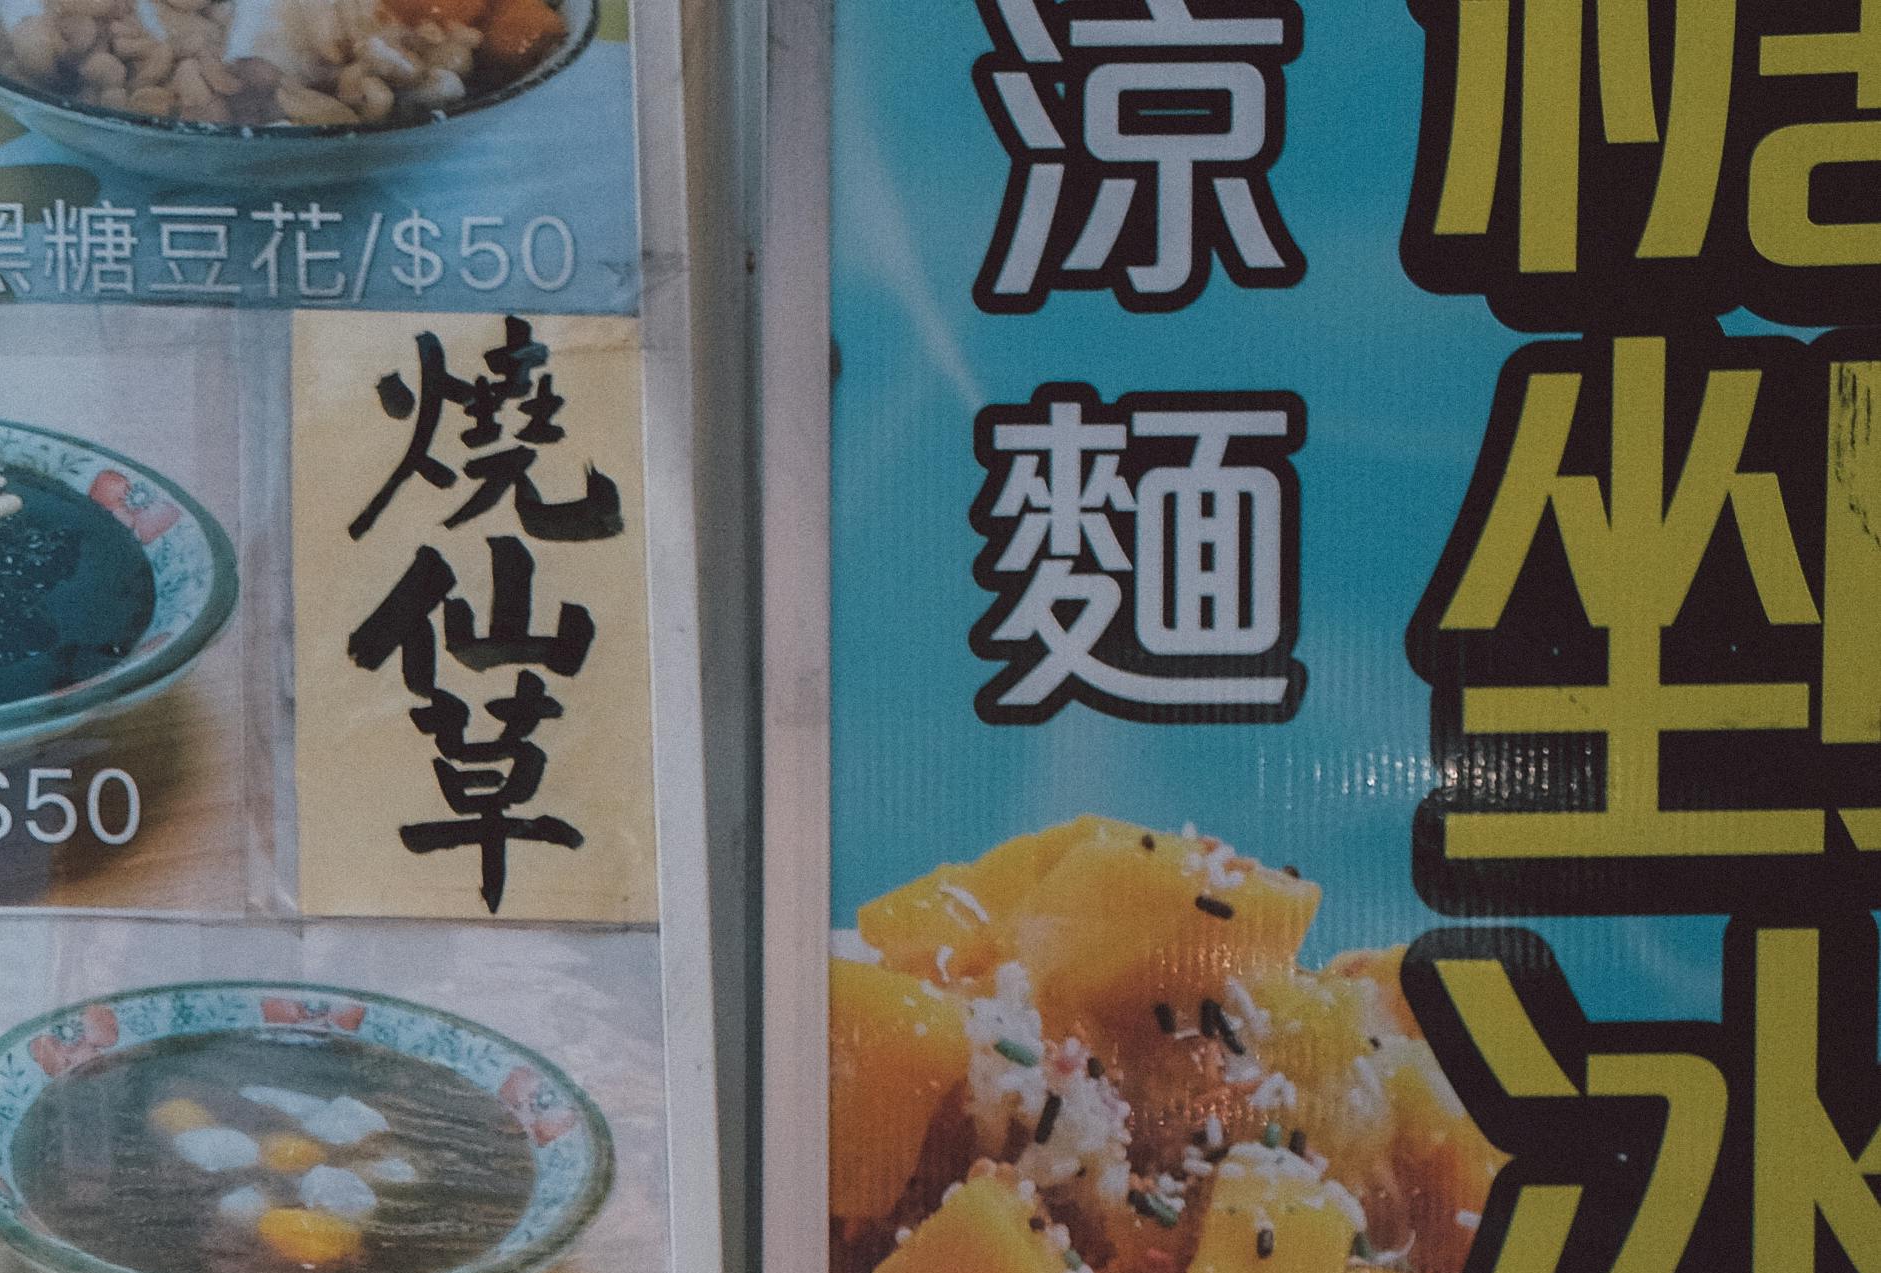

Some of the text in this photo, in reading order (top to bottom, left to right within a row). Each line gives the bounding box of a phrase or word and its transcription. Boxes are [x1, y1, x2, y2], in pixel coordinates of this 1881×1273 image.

[346, 313, 626, 914] 燒仙草
[990, 0, 1289, 707] 涼麵
